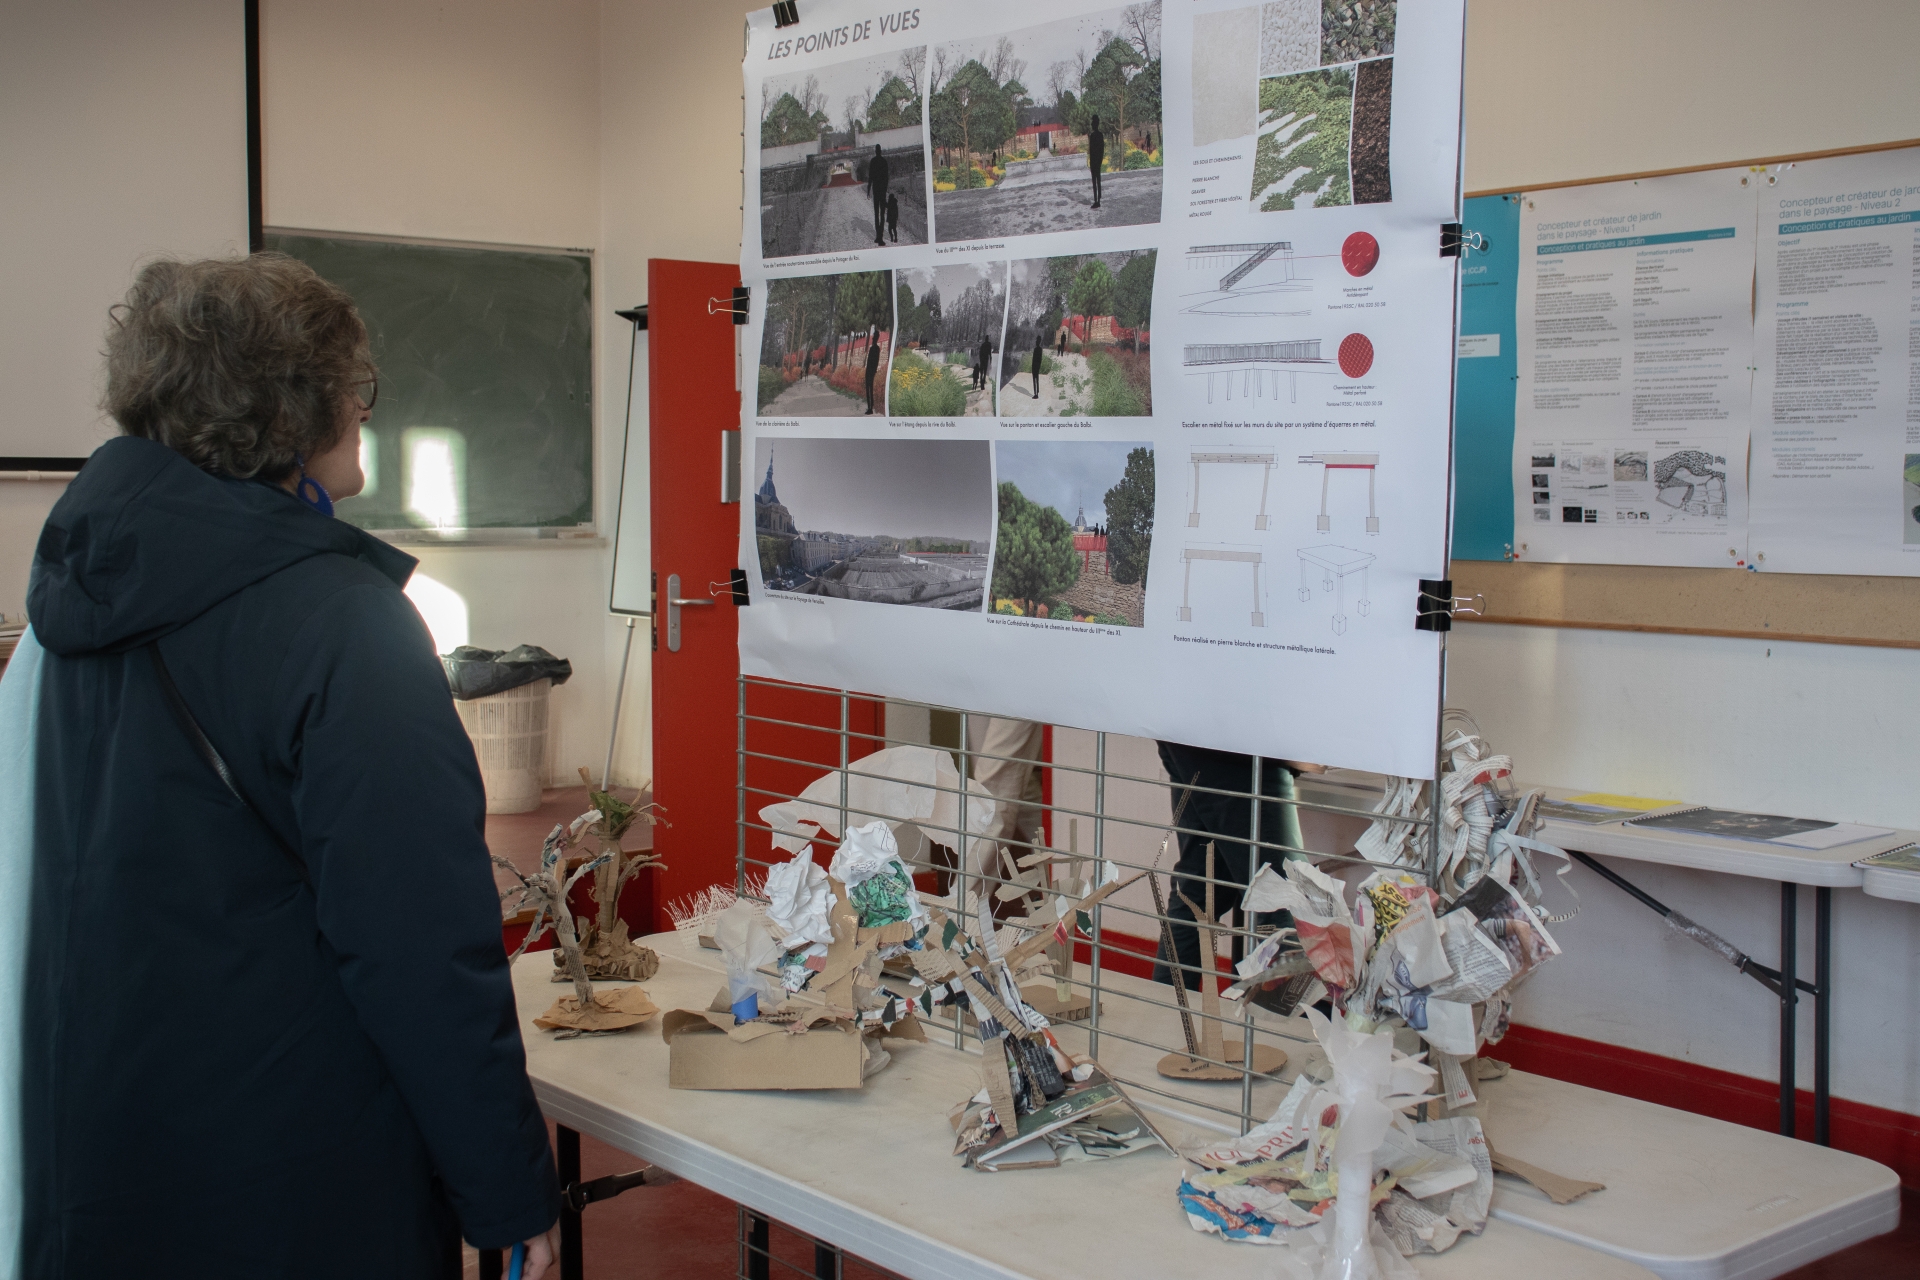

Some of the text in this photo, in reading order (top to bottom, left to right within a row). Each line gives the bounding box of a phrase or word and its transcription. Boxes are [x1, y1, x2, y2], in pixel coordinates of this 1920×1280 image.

[768, 8, 920, 60] LES POINTS DE VUES
[1779, 187, 1902, 208] Concepteur et créateur de
[1779, 208, 1801, 218] dans
[1814, 204, 1852, 216] paysage
[1861, 200, 1892, 210] Niveau
[1895, 198, 1900, 207] 2
[1537, 220, 1581, 232] Concepteur
[1593, 216, 1625, 225] créateur
[1627, 214, 1637, 222] de
[1639, 211, 1662, 223] jardin
[1782, 222, 1827, 233] Conception
[1838, 217, 1875, 230] pratiques
[1888, 213, 1911, 224] jardin
[1537, 232, 1555, 241] dans
[1557, 231, 1563, 239] le
[1565, 228, 1597, 241] paysage
[1604, 226, 1630, 234] Niveau
[1539, 244, 1576, 254] Conception
[1586, 240, 1616, 251] pratiques
[1626, 237, 1645, 247] jardin
[1007, 619, 1029, 627] Cathédrale
[1234, 640, 1255, 648] blanche
[1287, 645, 1313, 653] métallique
